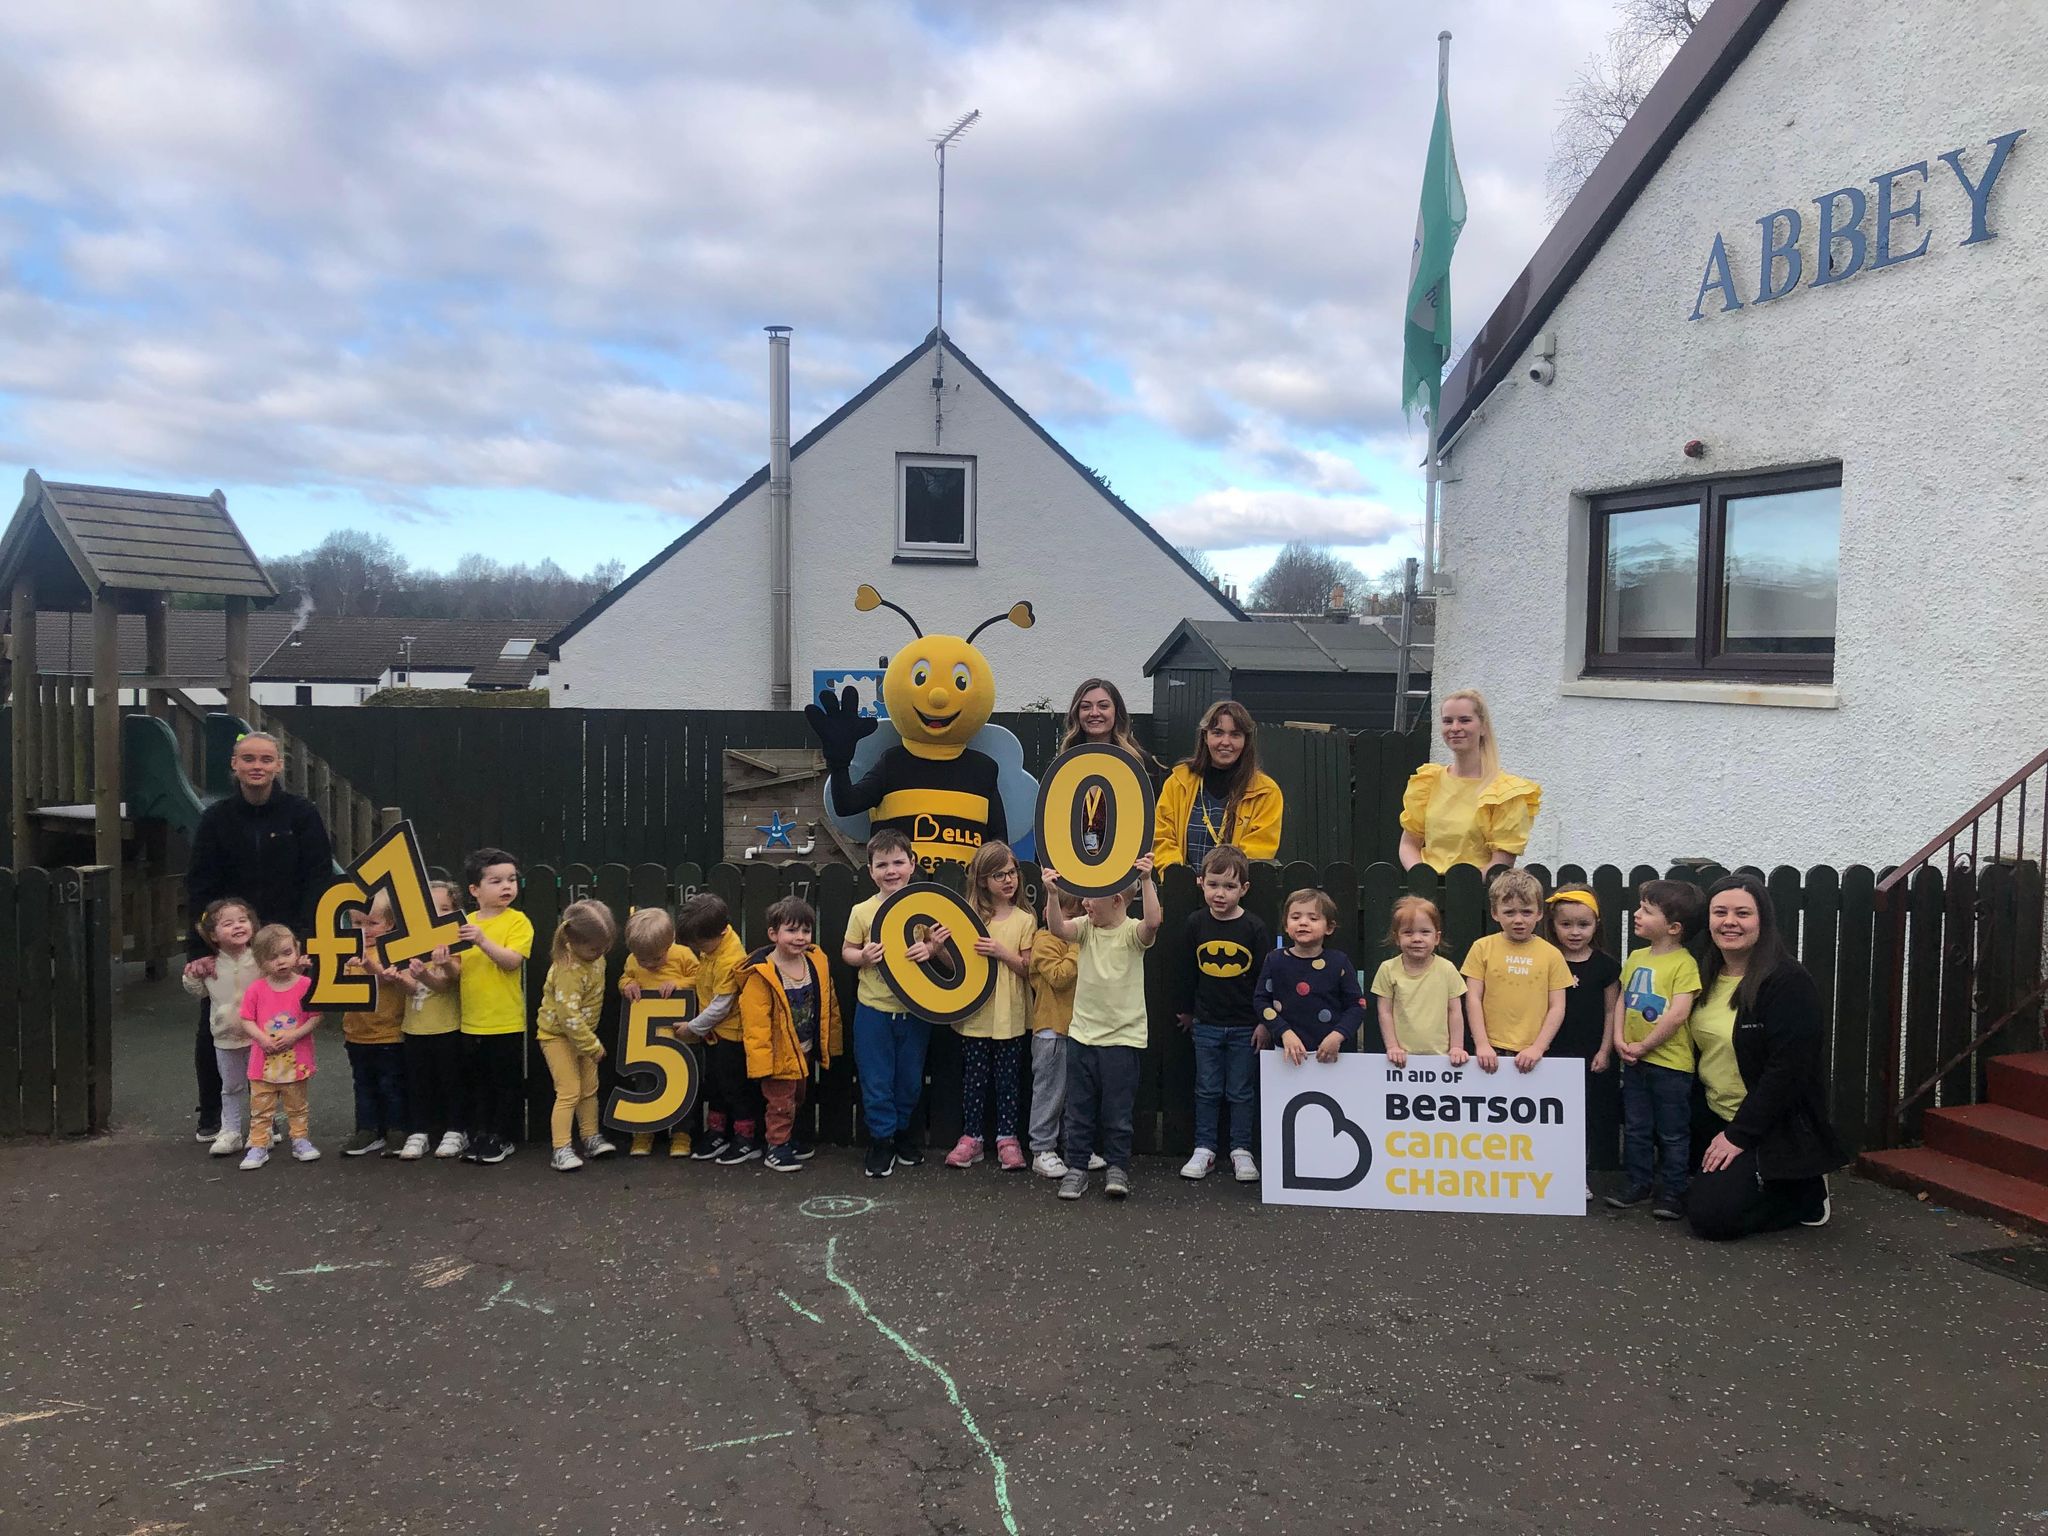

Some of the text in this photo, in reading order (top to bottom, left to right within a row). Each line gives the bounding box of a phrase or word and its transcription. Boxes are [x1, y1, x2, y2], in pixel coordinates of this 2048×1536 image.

[1688, 128, 2028, 322] ABBEY
[59, 881, 80, 904] 12
[567, 884, 589, 905] 15
[679, 883, 697, 906] 16
[789, 881, 810, 903] 17
[1505, 955, 1534, 966] HAVE
[1507, 966, 1529, 976] FUN
[1631, 993, 1640, 1006] 7
[603, 988, 699, 1133] 5
